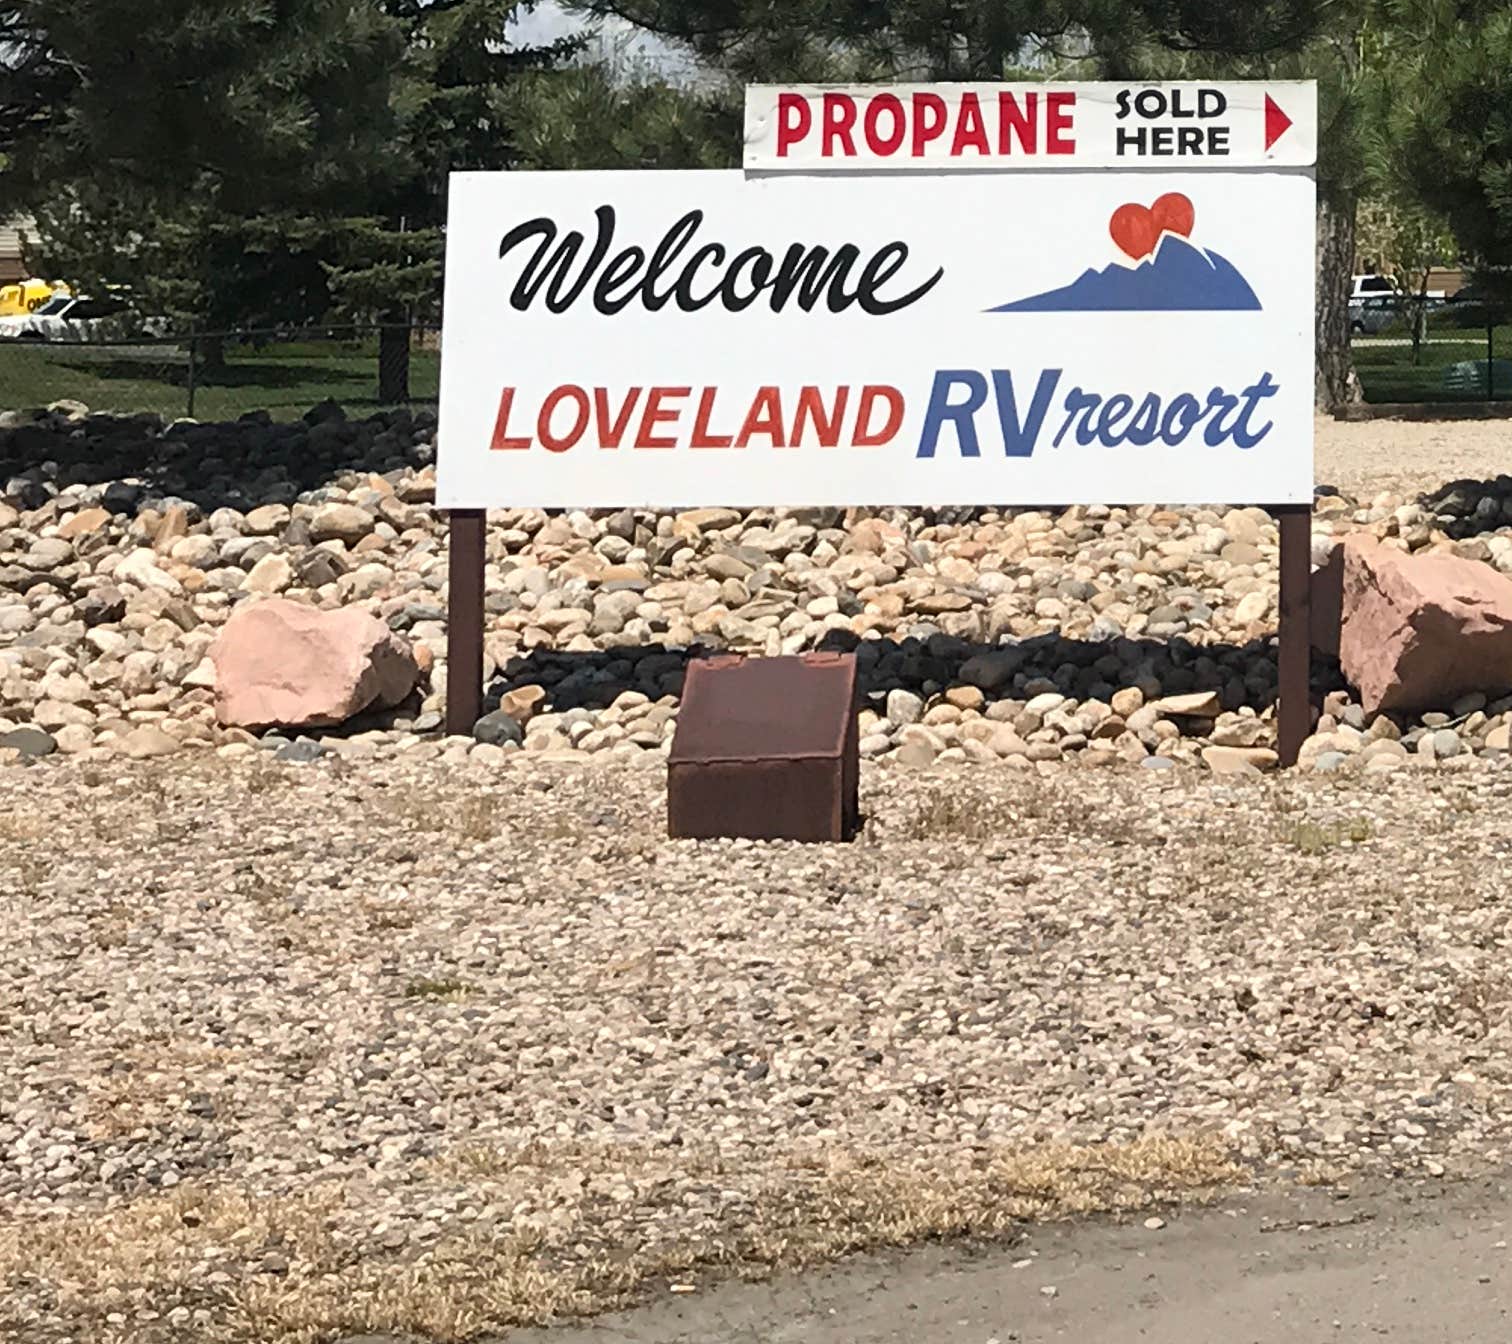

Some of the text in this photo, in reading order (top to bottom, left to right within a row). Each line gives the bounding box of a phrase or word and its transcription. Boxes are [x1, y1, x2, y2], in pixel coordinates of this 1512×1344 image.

[775, 91, 1077, 158] PROPANE
[1115, 89, 1228, 120] SOLD
[1115, 126, 1231, 156] HERE
[498, 204, 944, 316] Welcome
[490, 369, 1280, 459] LOVELAND RV resort
